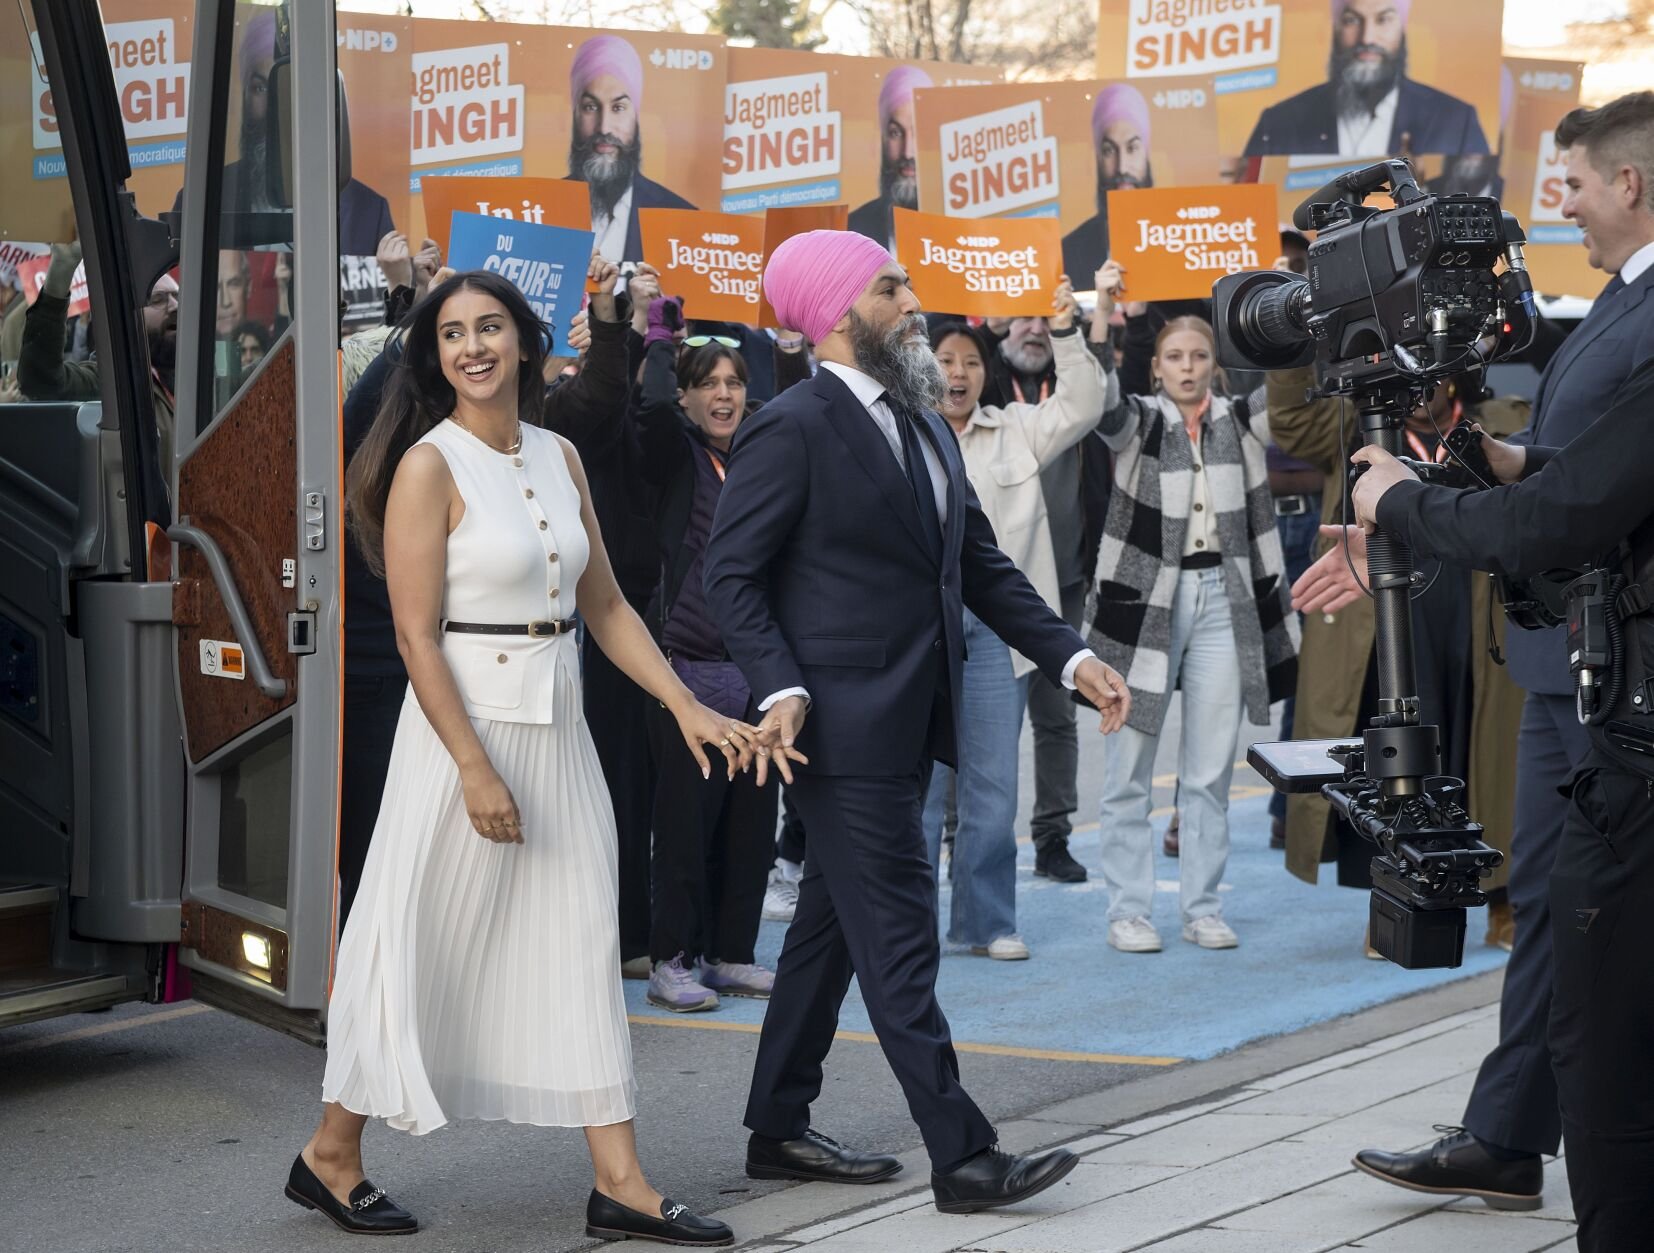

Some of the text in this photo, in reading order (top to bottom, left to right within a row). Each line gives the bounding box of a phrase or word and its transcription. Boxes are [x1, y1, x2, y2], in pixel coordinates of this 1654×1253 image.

[1137, 0, 1256, 27] Jagmee
[346, 28, 397, 53] NPD
[1134, 18, 1272, 70] SINGH
[666, 48, 713, 71] NPD
[724, 82, 822, 129] Jagmeet
[412, 98, 517, 150] INGH
[948, 111, 1038, 163] Jagmeet
[722, 123, 835, 175] SINGH
[949, 150, 1053, 210] SINGH
[1187, 205, 1221, 219] NDP
[496, 234, 514, 253] DU
[711, 232, 740, 246] NDP
[966, 236, 1000, 248] NDP
[1135, 217, 1258, 253] Jagmeet
[920, 237, 1039, 274] Jagmeet
[1184, 242, 1259, 275] Singh
[547, 273, 562, 291] AU
[965, 267, 1041, 298] Singh
